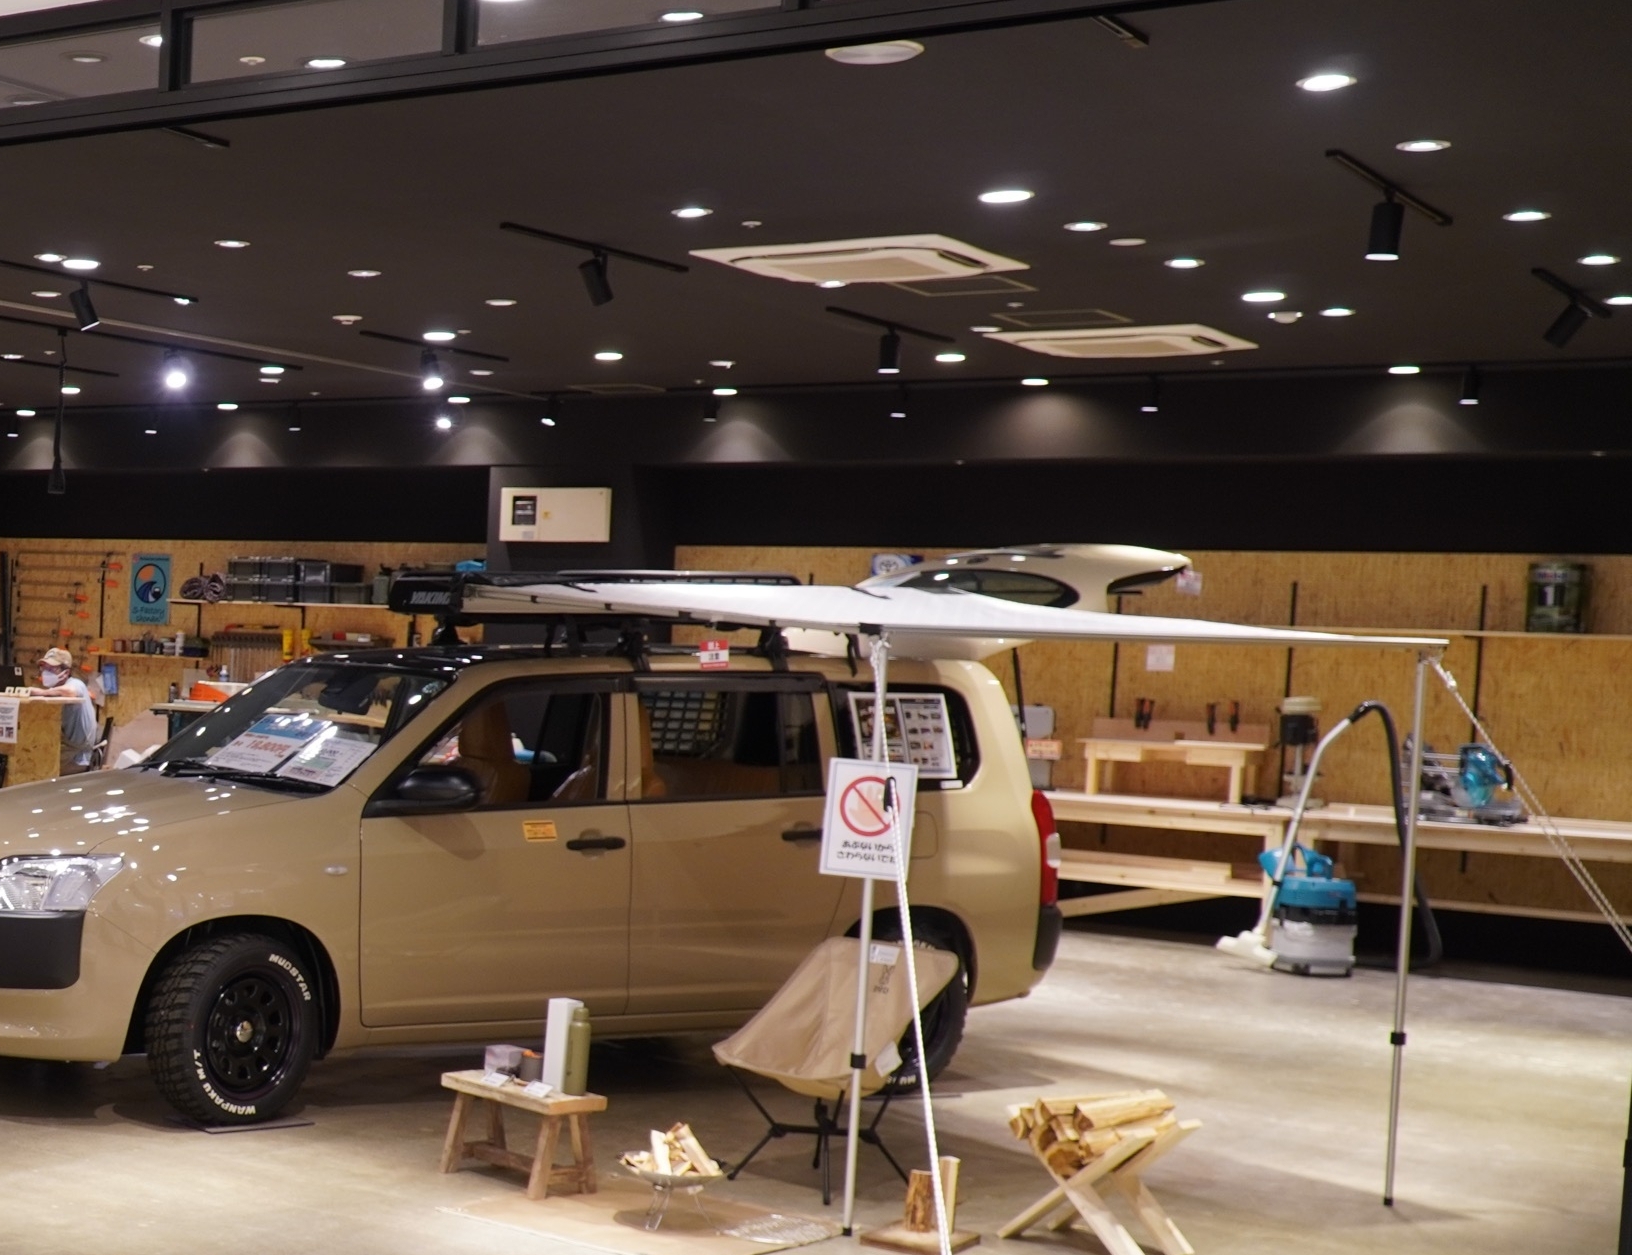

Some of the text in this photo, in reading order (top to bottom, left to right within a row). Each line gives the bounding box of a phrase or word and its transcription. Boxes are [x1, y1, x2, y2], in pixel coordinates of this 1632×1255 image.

[409, 591, 452, 605] YAKIM
[269, 953, 312, 1001] MUDSTAR
[193, 1049, 256, 1115] WANPAKU M/T
